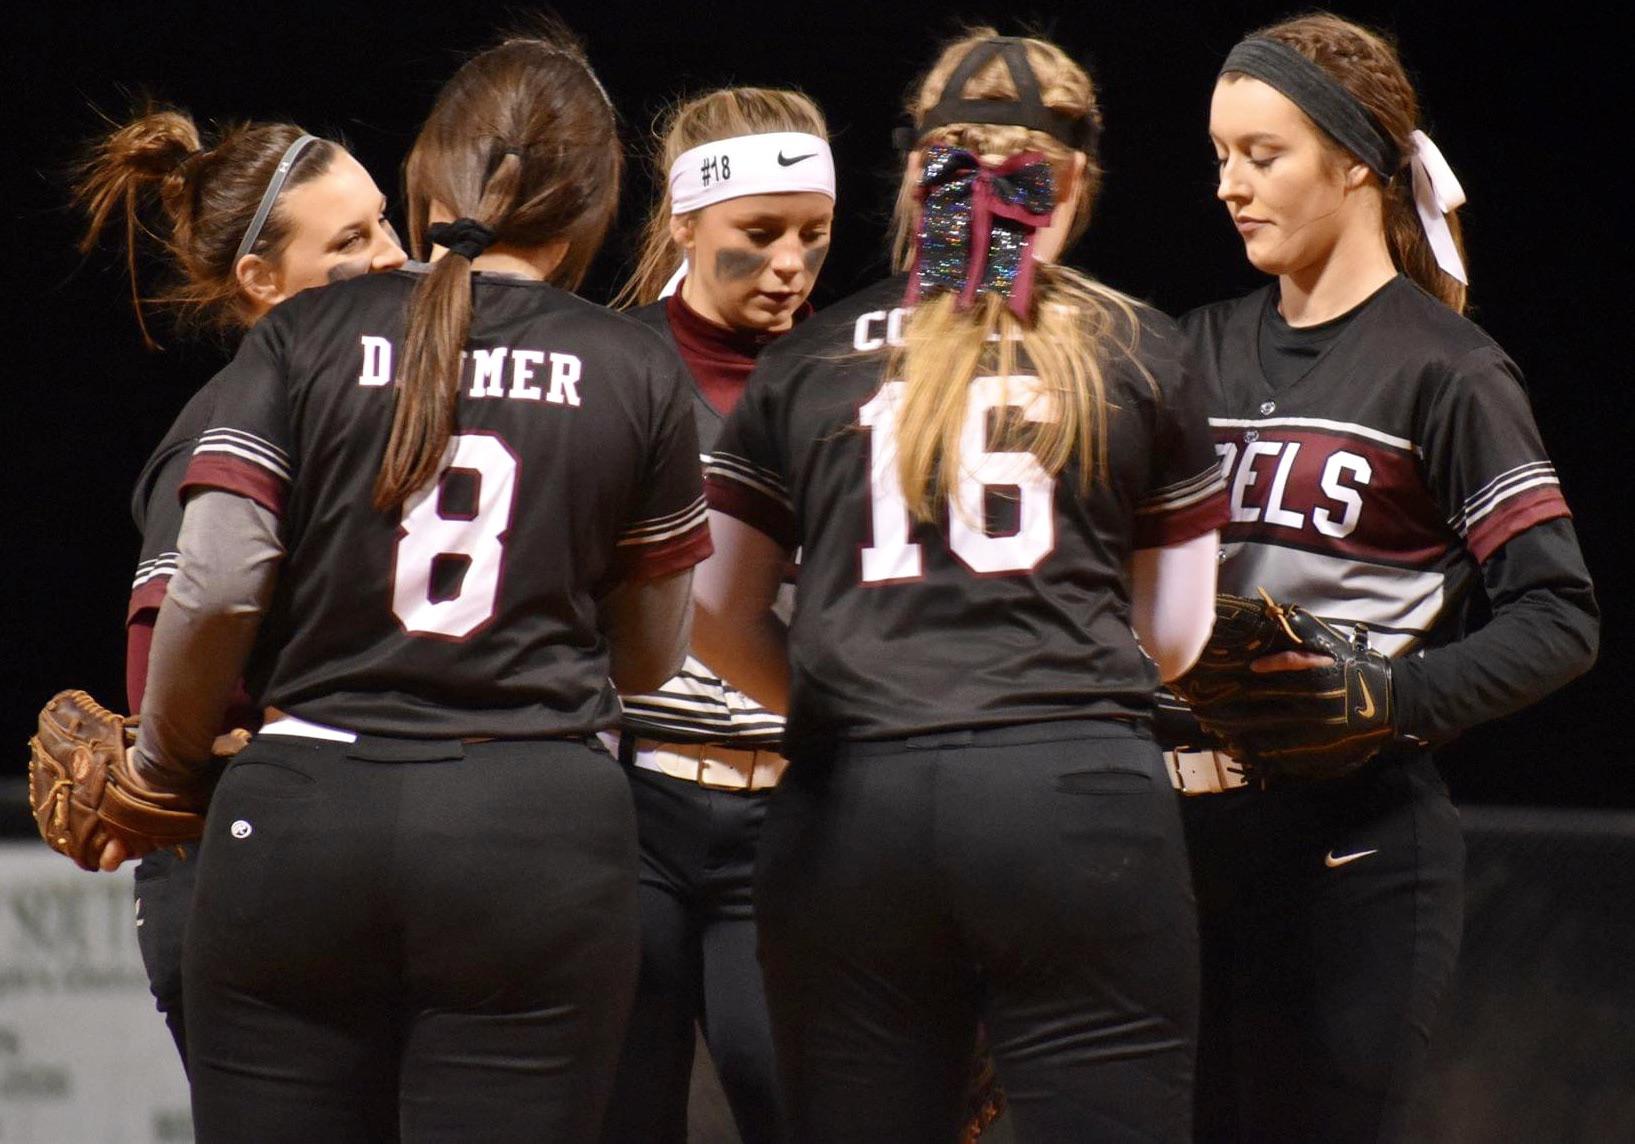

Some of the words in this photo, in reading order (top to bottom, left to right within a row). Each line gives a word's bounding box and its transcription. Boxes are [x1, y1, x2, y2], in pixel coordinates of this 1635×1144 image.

[700, 155, 731, 187] #18
[358, 335, 582, 406] DMER
[390, 430, 521, 641] 8
[859, 374, 1056, 584] 16
